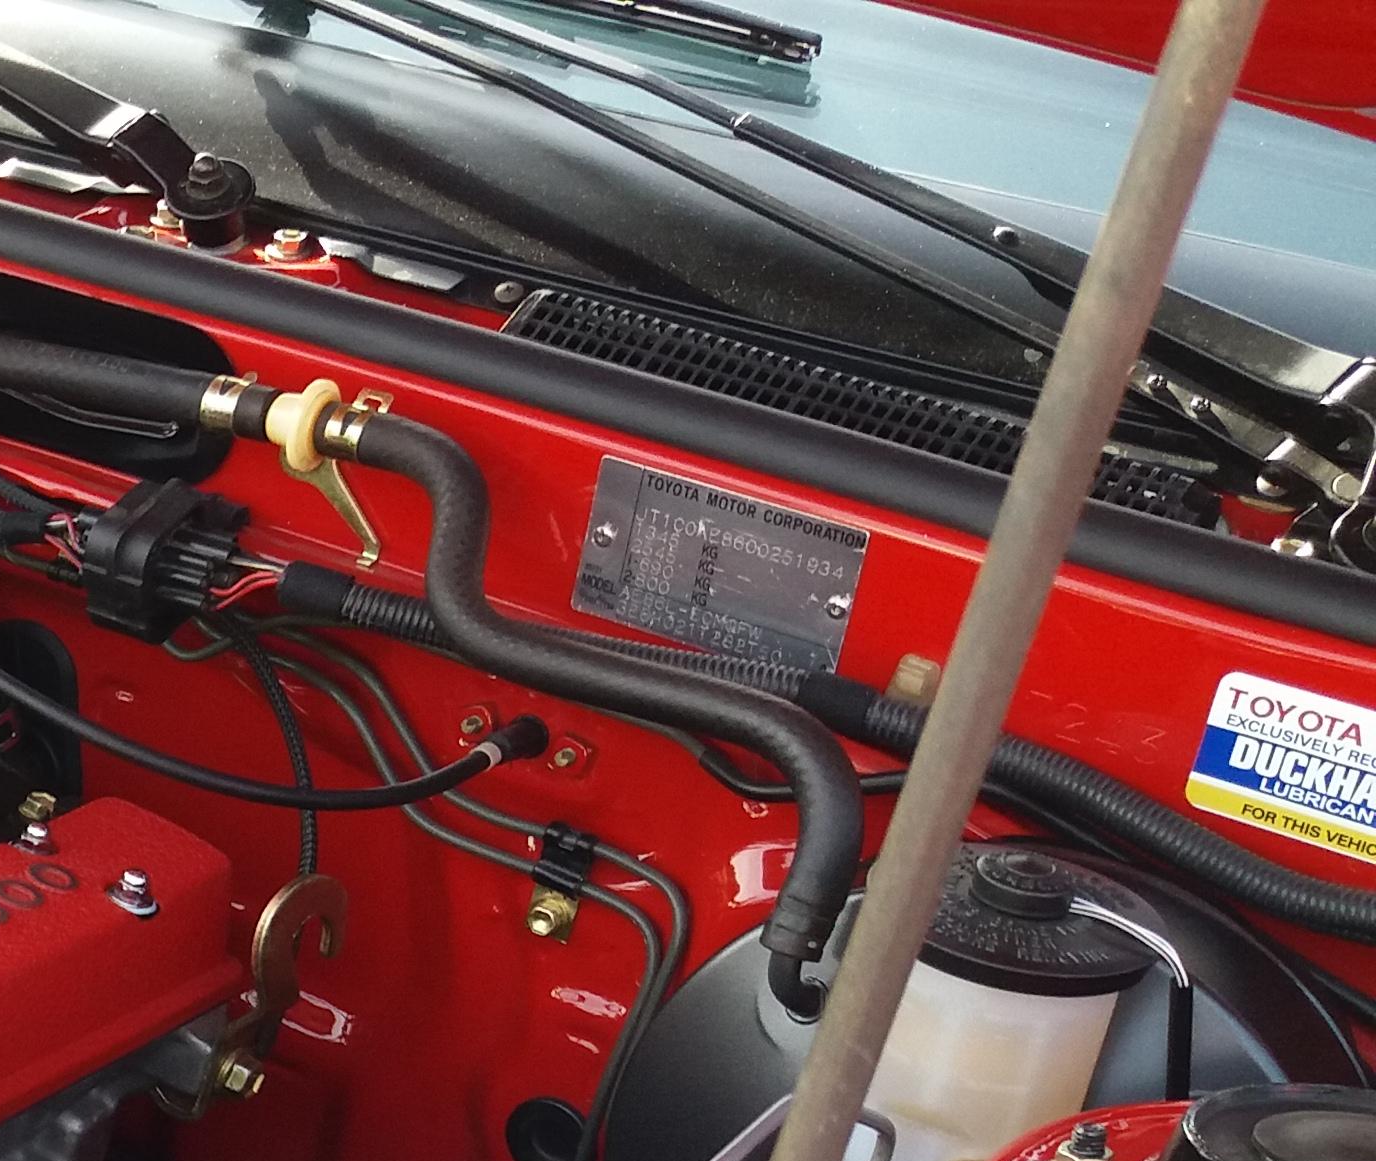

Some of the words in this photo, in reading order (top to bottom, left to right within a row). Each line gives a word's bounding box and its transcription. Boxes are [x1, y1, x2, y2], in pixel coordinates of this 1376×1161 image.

[648, 474, 699, 502] TOYOTA
[706, 492, 756, 518] MOTOR
[763, 510, 867, 549] CORPORATION
[701, 543, 719, 559] KG
[698, 559, 715, 575] KG
[581, 572, 617, 596] MODEL
[694, 576, 712, 592] KG
[690, 593, 707, 608] KG
[1229, 686, 1362, 747] TOYOTA
[1226, 713, 1344, 758] EXCLUSIVELY
[1259, 777, 1376, 826] LUBRICAN
[1241, 803, 1277, 825] FOR
[1282, 815, 1322, 839] THIS
